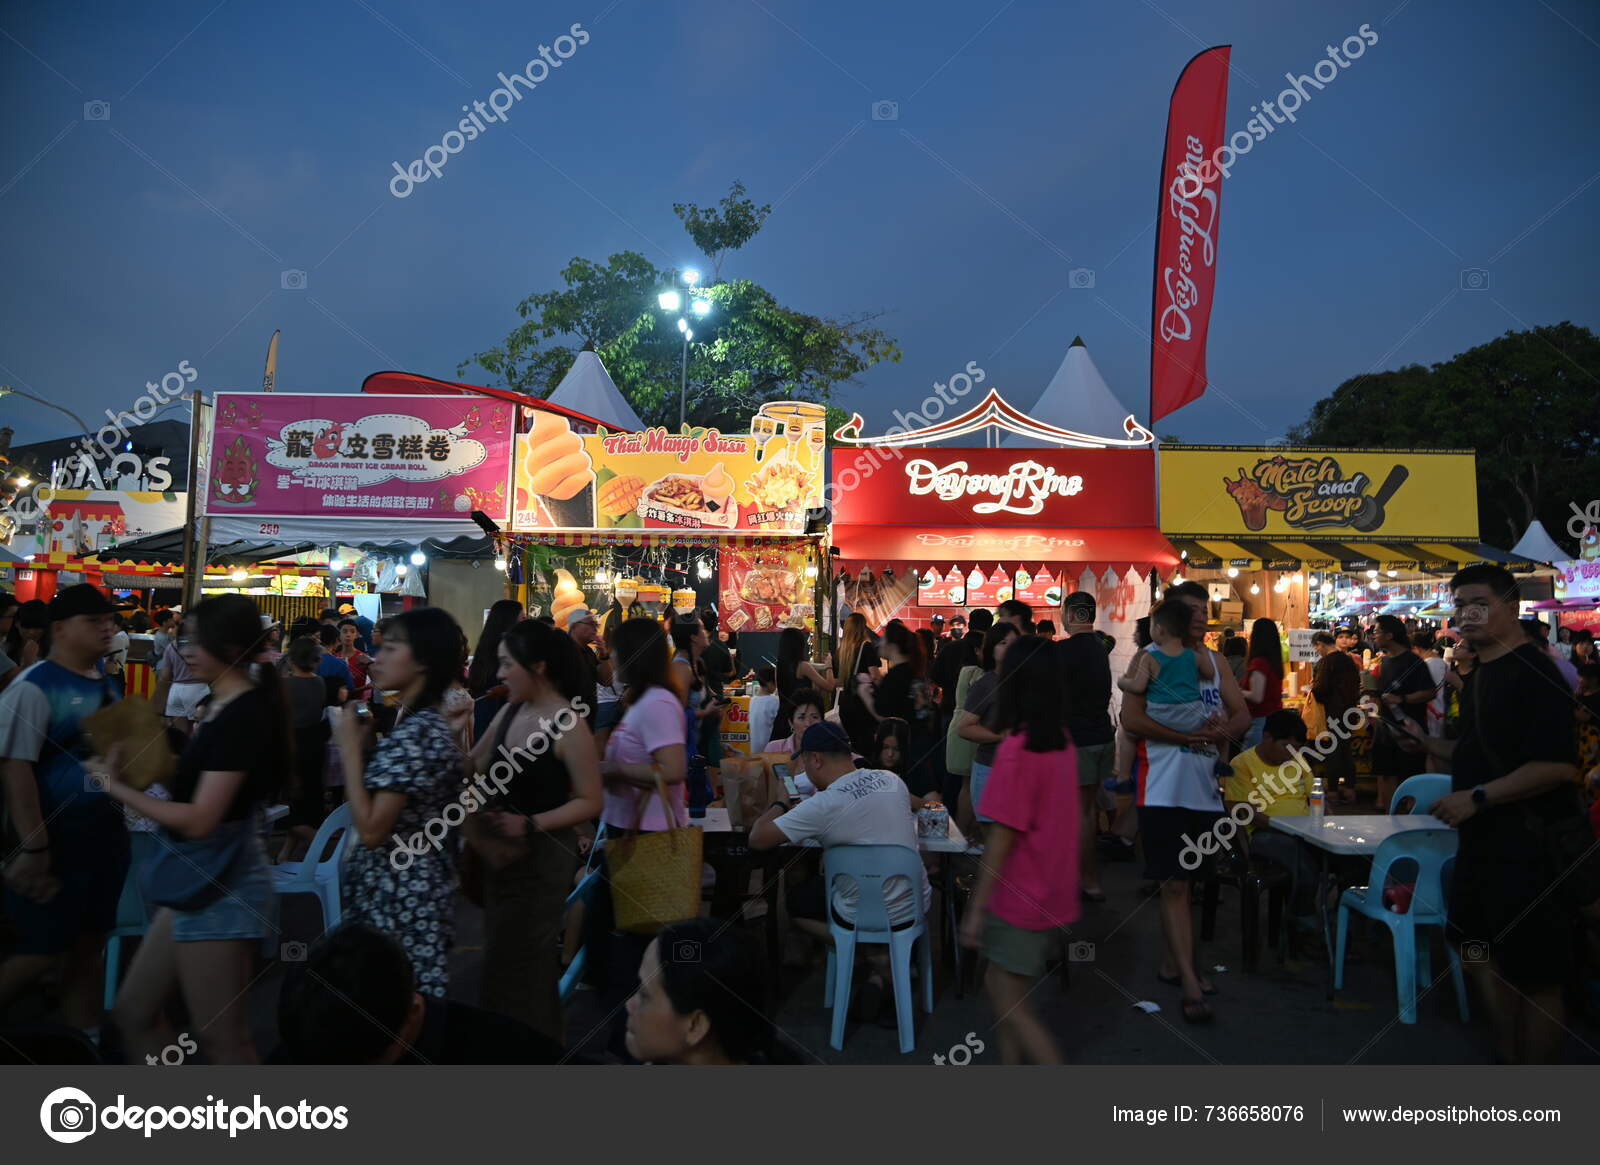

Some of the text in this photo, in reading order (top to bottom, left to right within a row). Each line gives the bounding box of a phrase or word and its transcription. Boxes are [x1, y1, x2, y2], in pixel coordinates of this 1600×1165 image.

[603, 427, 748, 462] Thai Mango Susu
[308, 461, 339, 469] DRAGON
[380, 463, 407, 471] CREAM
[1254, 458, 1335, 491] Match
[1318, 474, 1362, 495] and
[1286, 490, 1363, 521] Scoop
[259, 523, 280, 535] 250
